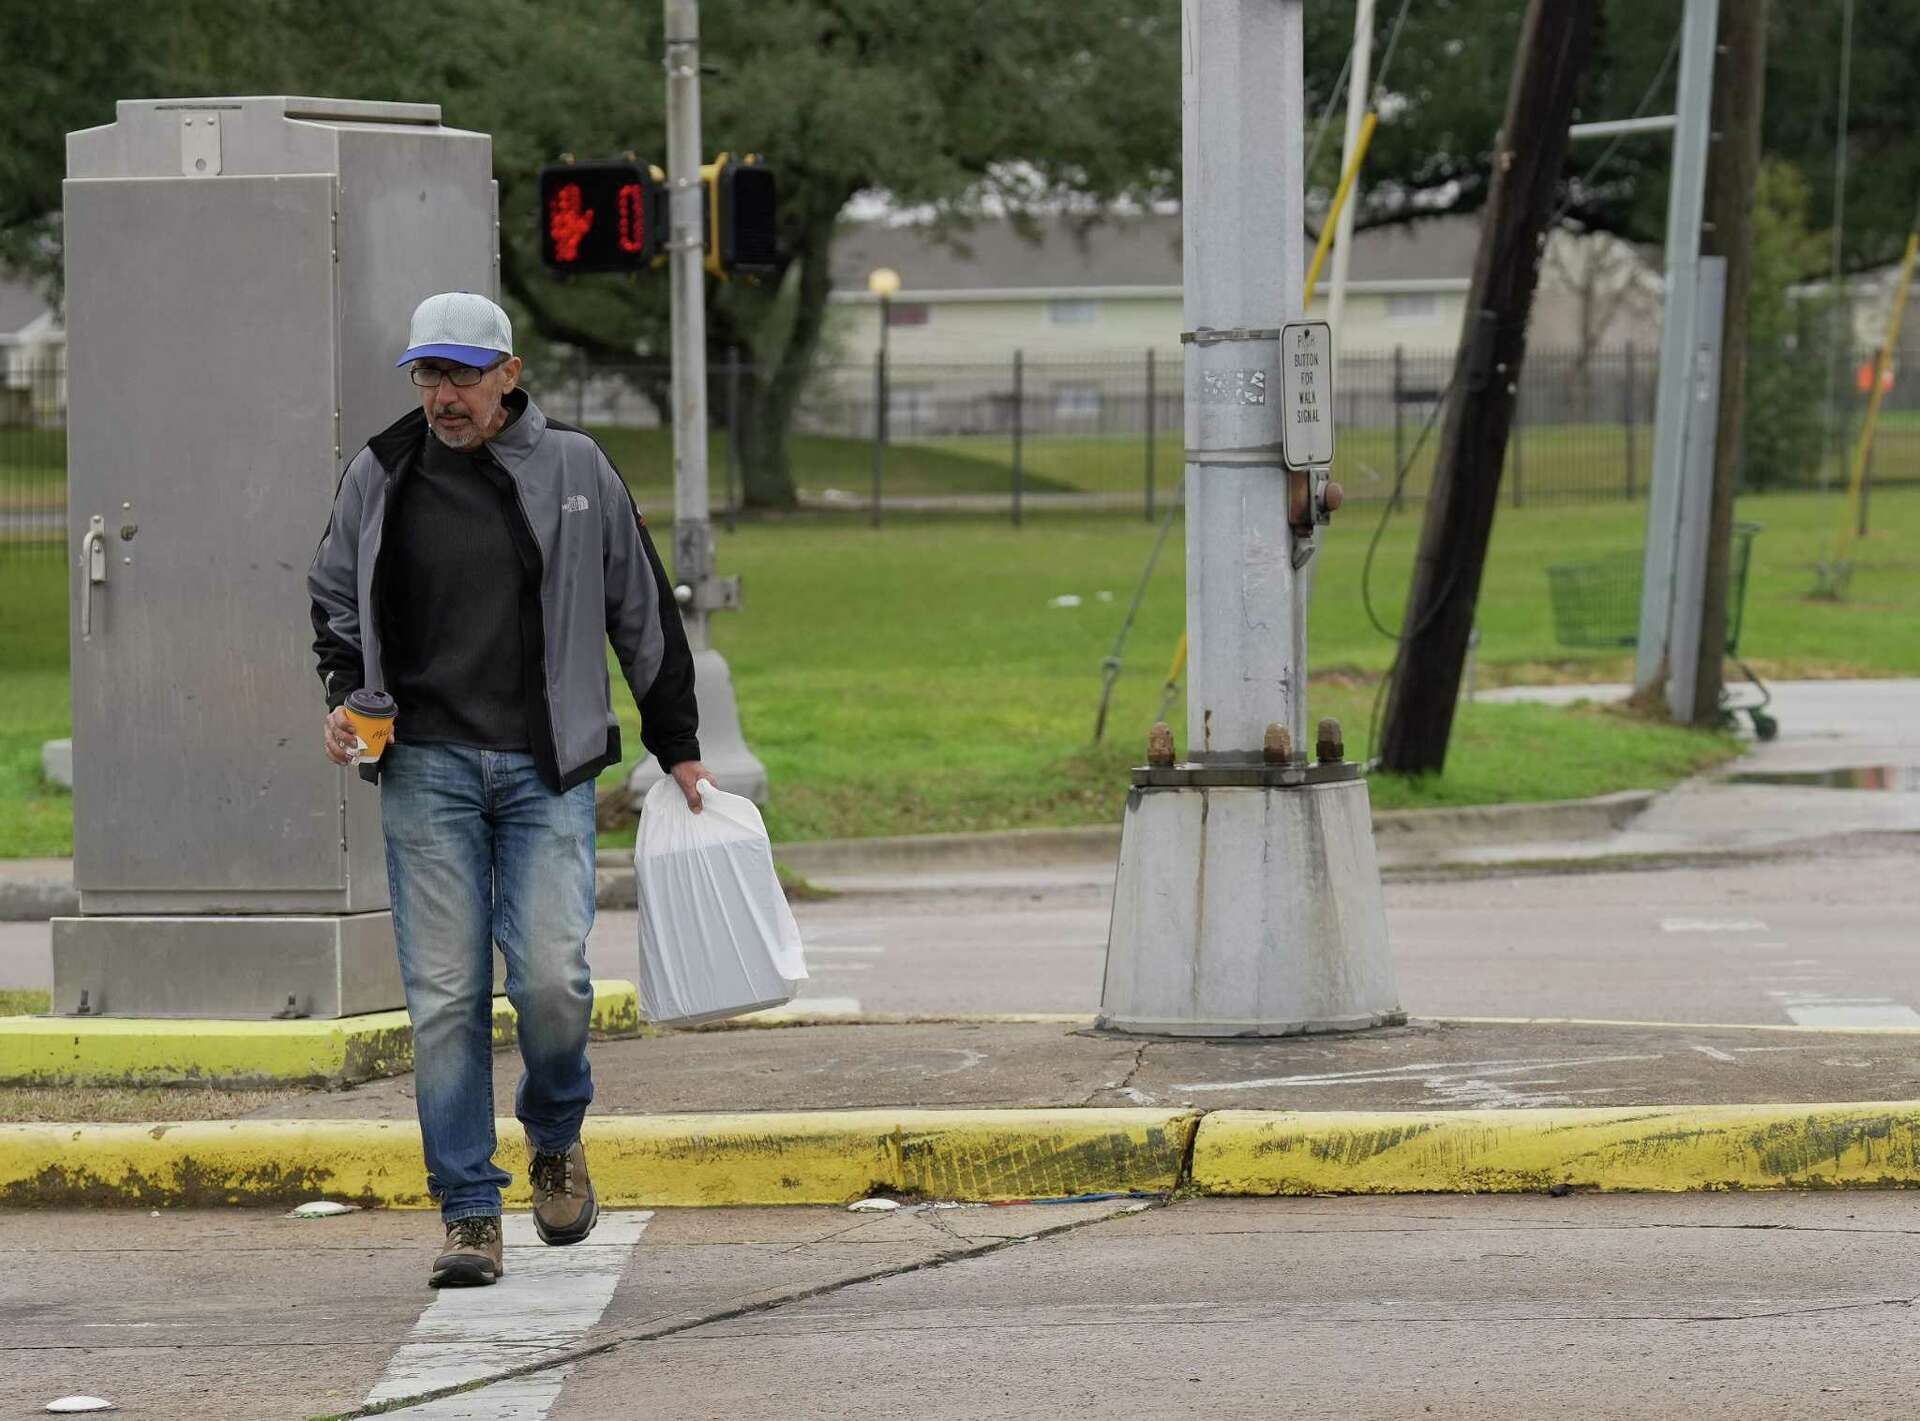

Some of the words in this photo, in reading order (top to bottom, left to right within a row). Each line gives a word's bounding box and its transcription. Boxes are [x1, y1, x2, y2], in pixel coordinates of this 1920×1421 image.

[1294, 353, 1319, 367] BUTTON
[1301, 372, 1313, 385] FOR
[1299, 392, 1316, 405] WALK
[1297, 410, 1320, 424] SIGNAL
